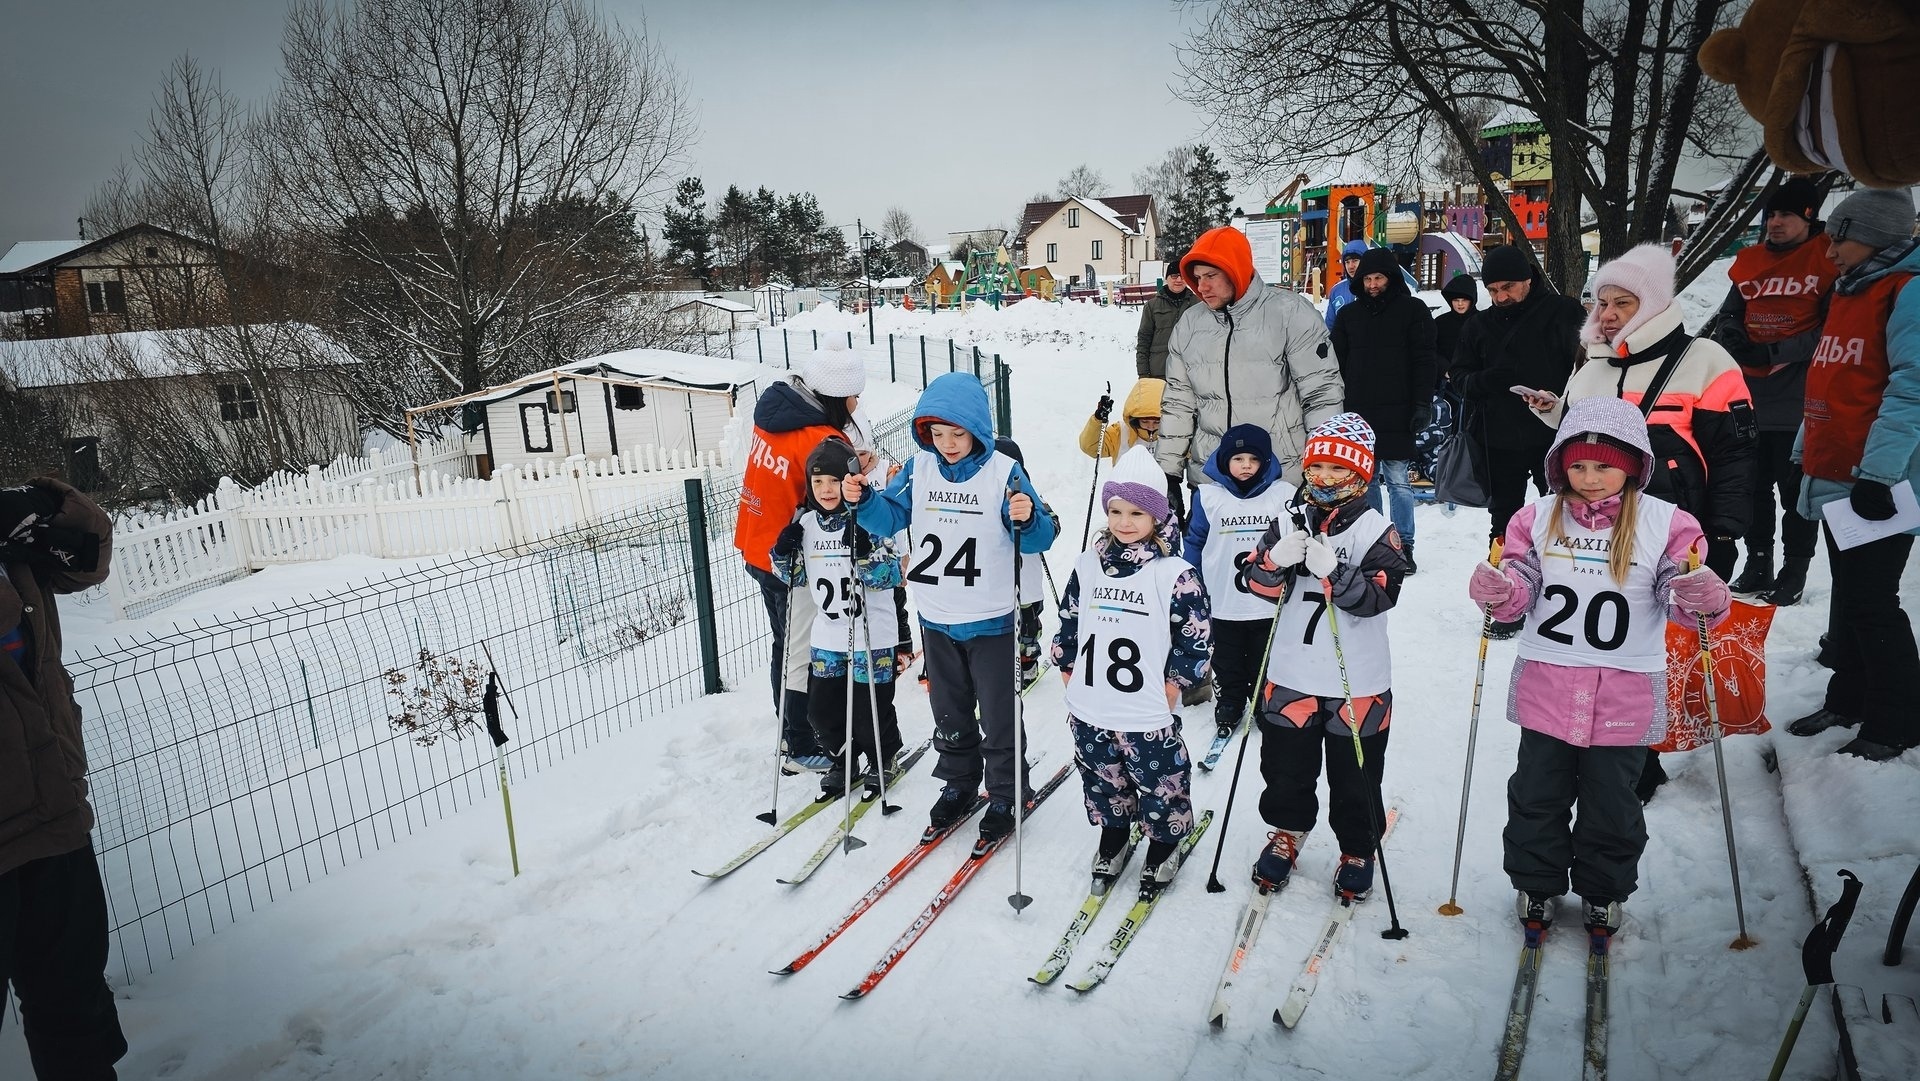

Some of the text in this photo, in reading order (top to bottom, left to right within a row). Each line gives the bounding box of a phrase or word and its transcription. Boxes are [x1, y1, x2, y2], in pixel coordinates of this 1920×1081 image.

[1738, 275, 1819, 300] СУДЬЯ
[1812, 336, 1864, 368] ДЬЯ
[750, 432, 789, 480] УДЬЯ
[928, 491, 979, 505] MAXIMA
[1221, 515, 1272, 527] MAXIMA
[814, 540, 850, 550] MAXIM
[906, 533, 981, 586] 24
[1554, 536, 1612, 552] MAXI
[1573, 567, 1603, 575] PARK
[816, 577, 863, 620] 25
[1302, 591, 1329, 645] 7
[1483, 602, 1493, 639] sonata
[1537, 584, 1630, 651] 20
[1697, 612, 1709, 651] sonata
[1081, 633, 1144, 693] 18
